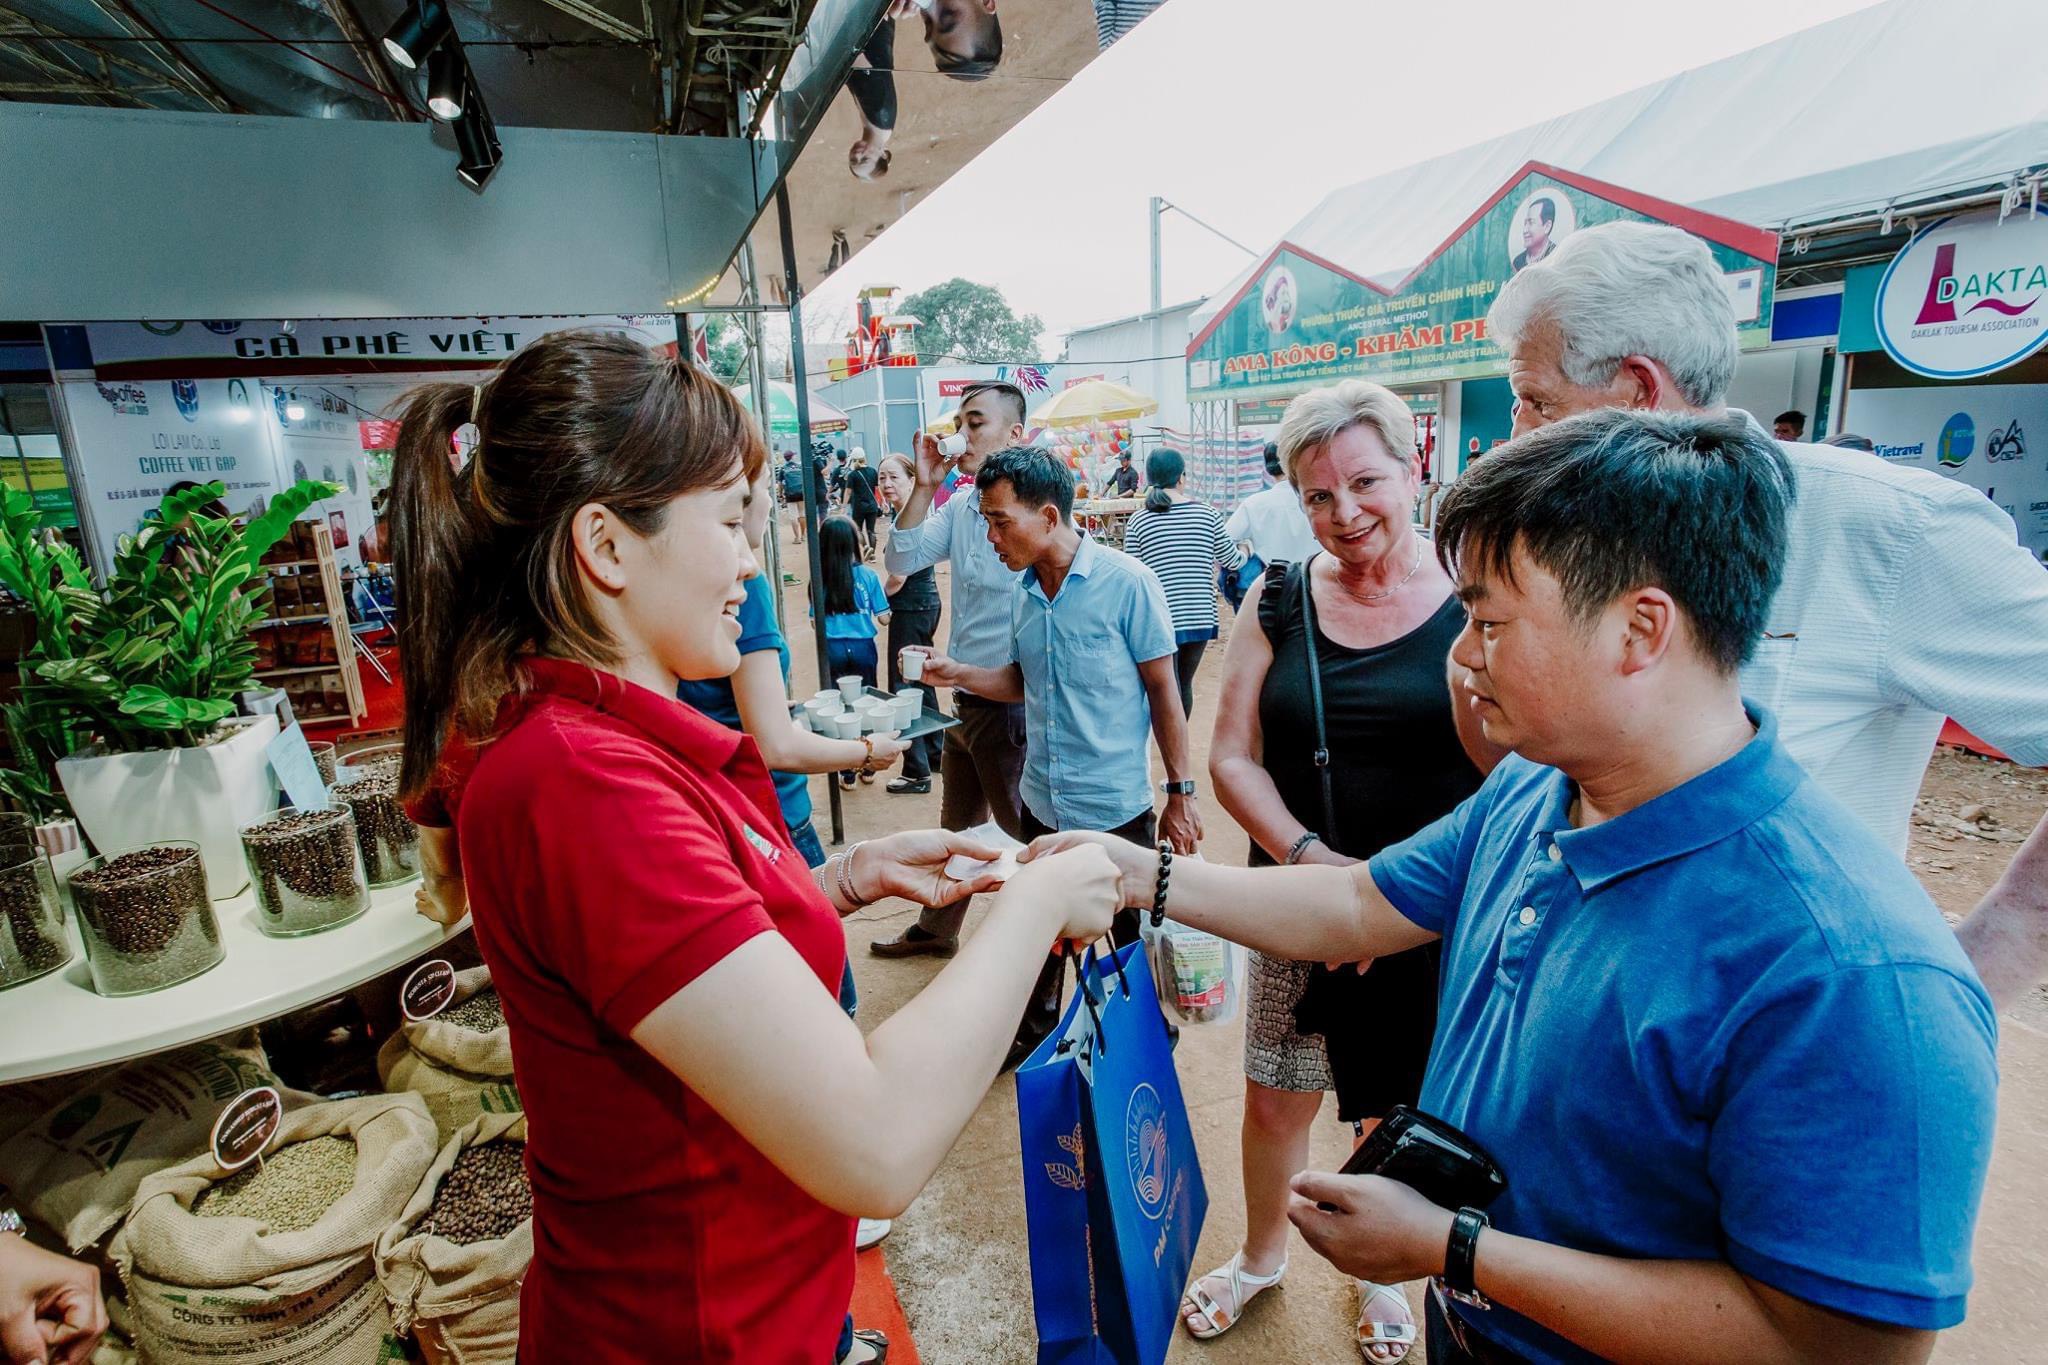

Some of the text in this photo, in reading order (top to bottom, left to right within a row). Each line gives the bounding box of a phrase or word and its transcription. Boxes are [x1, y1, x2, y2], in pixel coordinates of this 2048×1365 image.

[1393, 310, 1428, 324] METHOD
[1980, 317, 2040, 332] ASSOCIATION
[322, 331, 412, 355] PHÊ
[429, 329, 521, 355] VIỆT
[1224, 353, 1269, 375] AMA
[1272, 342, 1337, 368] KÔNG
[1355, 325, 1445, 357] KHĂM
[1451, 318, 1492, 343] PH
[1874, 442, 1924, 457] Vietravel
[138, 456, 185, 474] COFFEE
[173, 1307, 214, 1325] CÔNG
